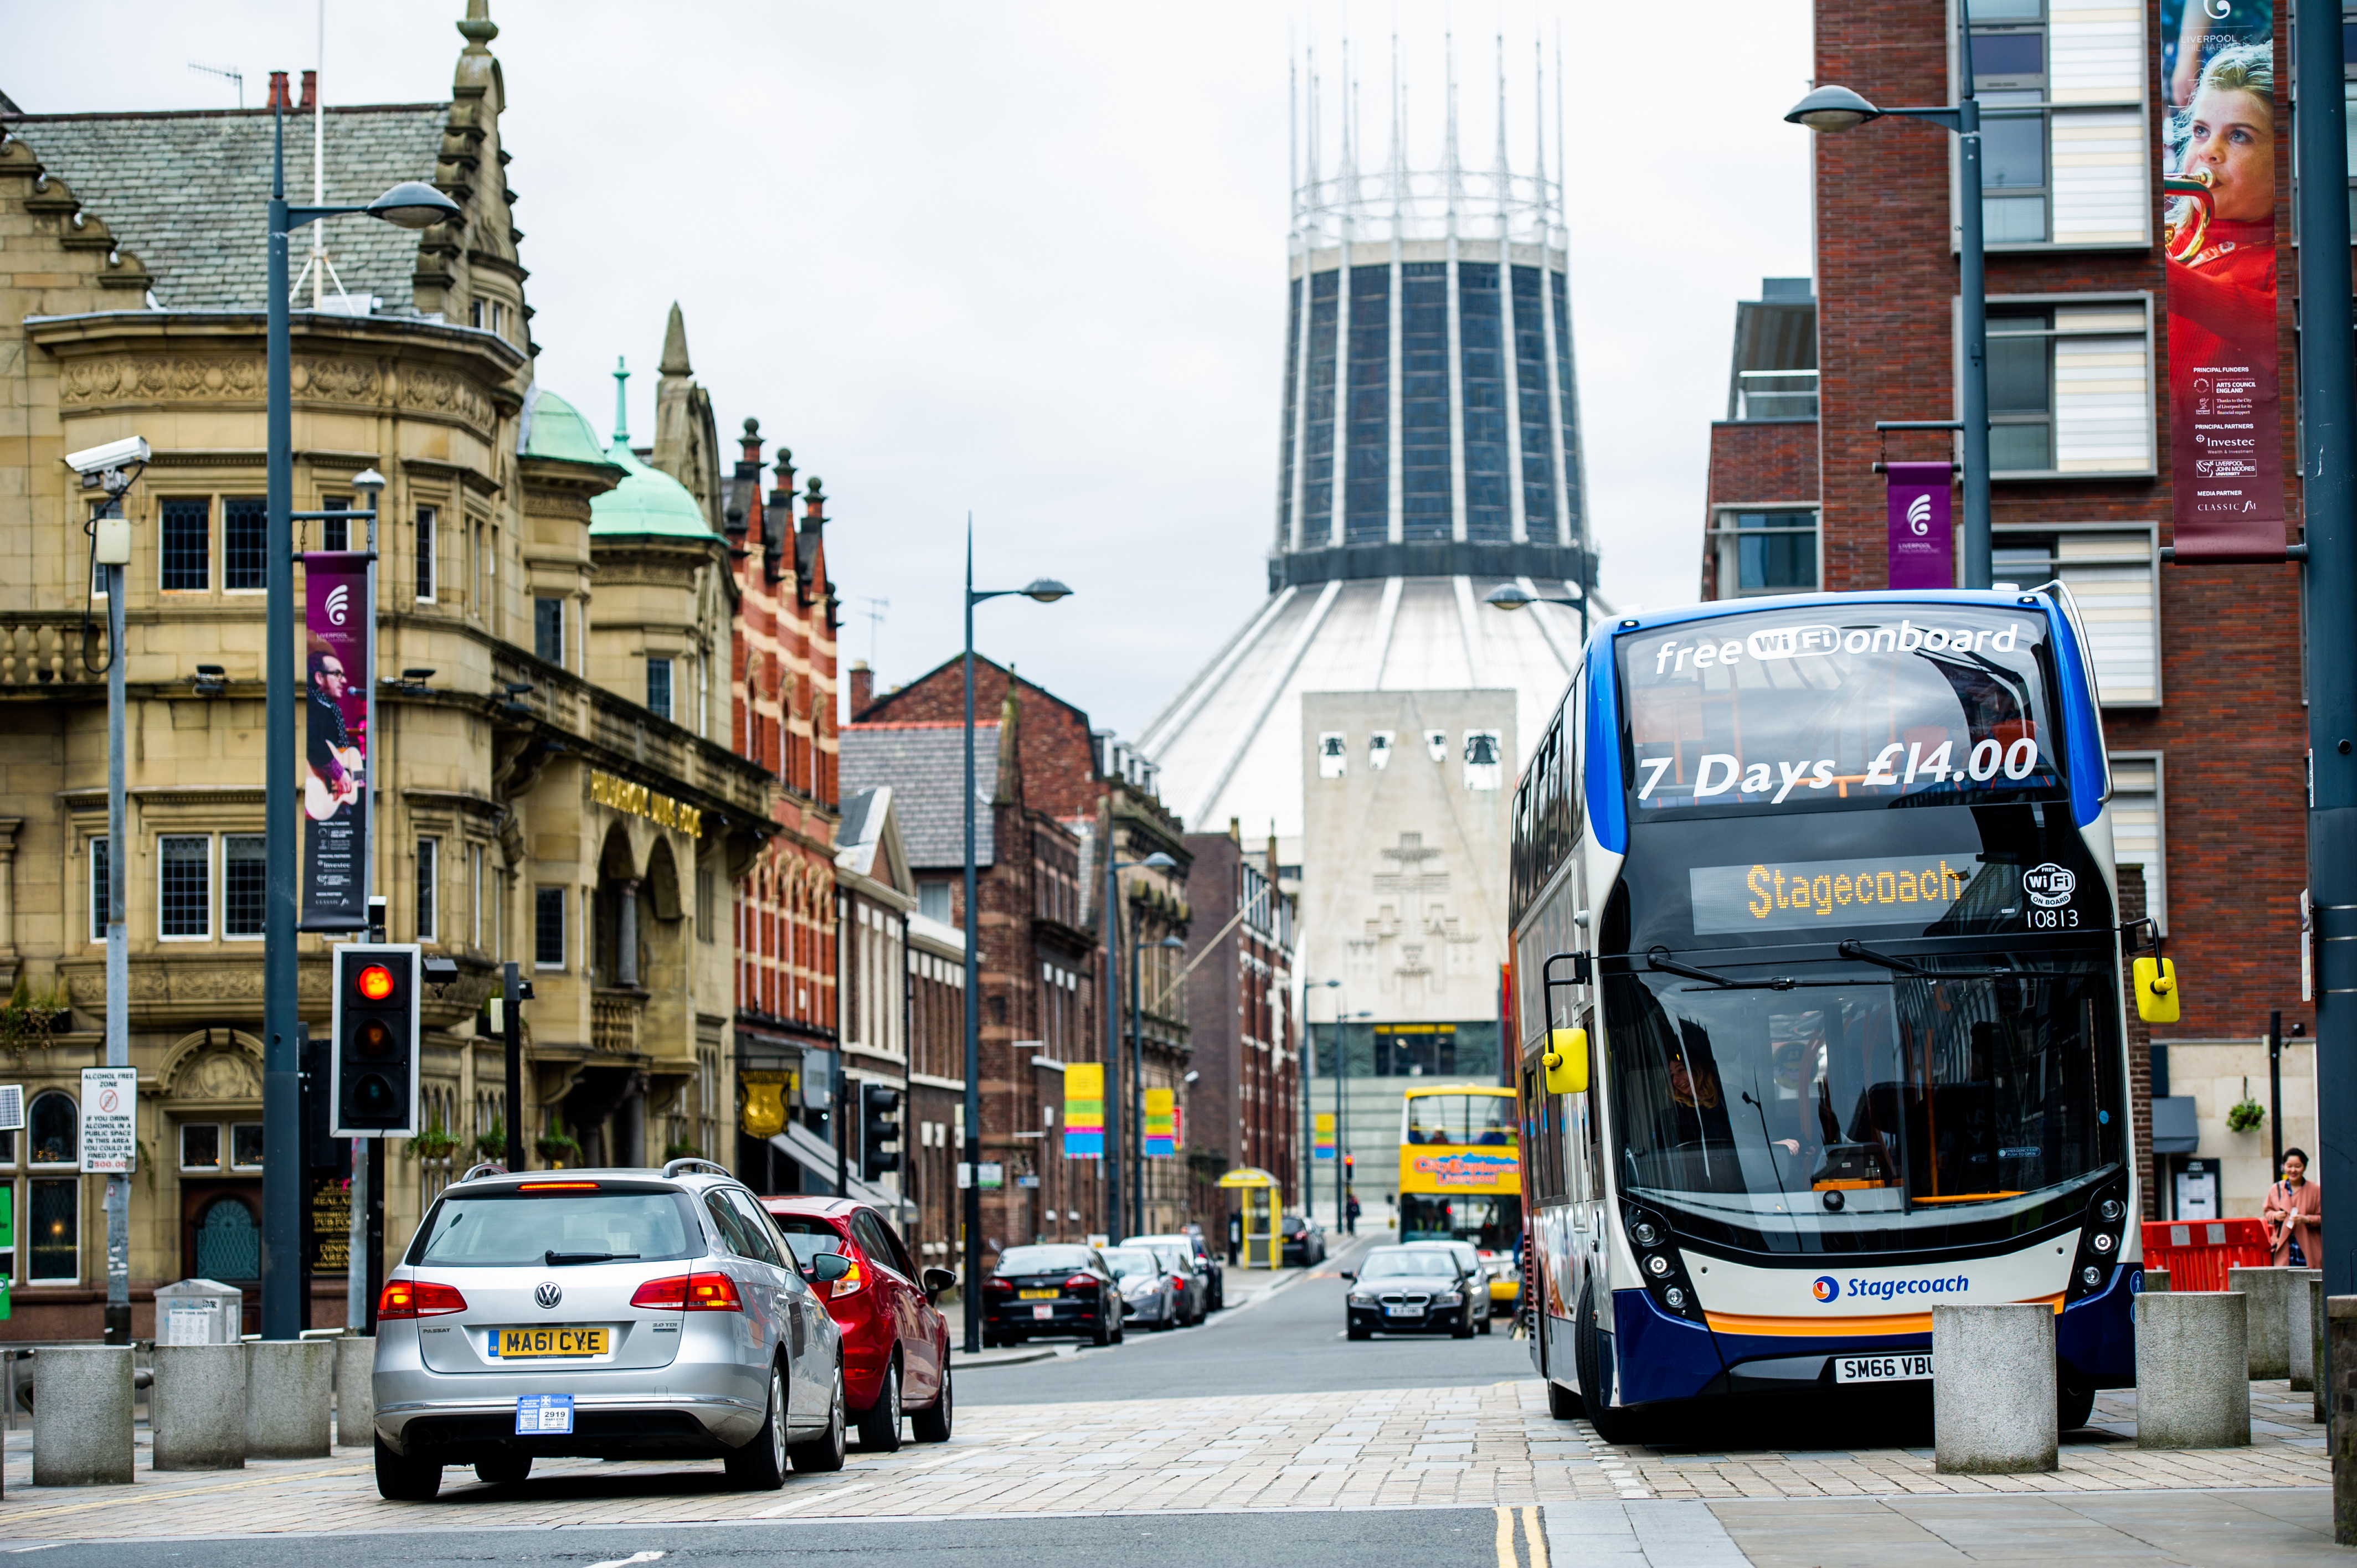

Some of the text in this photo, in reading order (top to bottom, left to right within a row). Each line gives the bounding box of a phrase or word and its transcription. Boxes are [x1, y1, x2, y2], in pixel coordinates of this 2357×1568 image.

[2181, 34, 2237, 43] LIVERPOOL
[2207, 437, 2255, 446] Investec
[1655, 639, 1742, 674] free
[1844, 620, 2019, 654] onboard
[1638, 737, 2038, 804] 7 Days £14.00
[1747, 860, 1960, 919] Stagecoach
[2045, 895, 2070, 905] BOARD
[2027, 910, 2078, 928] 10813
[1414, 1158, 1448, 1173] City
[1438, 1174, 1496, 1185] Liverpool
[313, 1196, 339, 1206] REAL
[315, 1218, 333, 1227] PUB
[320, 1244, 349, 1252] DININ
[1847, 1275, 1969, 1301] Stagecoach
[506, 1332, 600, 1352] MA61 CYE
[1845, 1358, 1895, 1379] SM66
